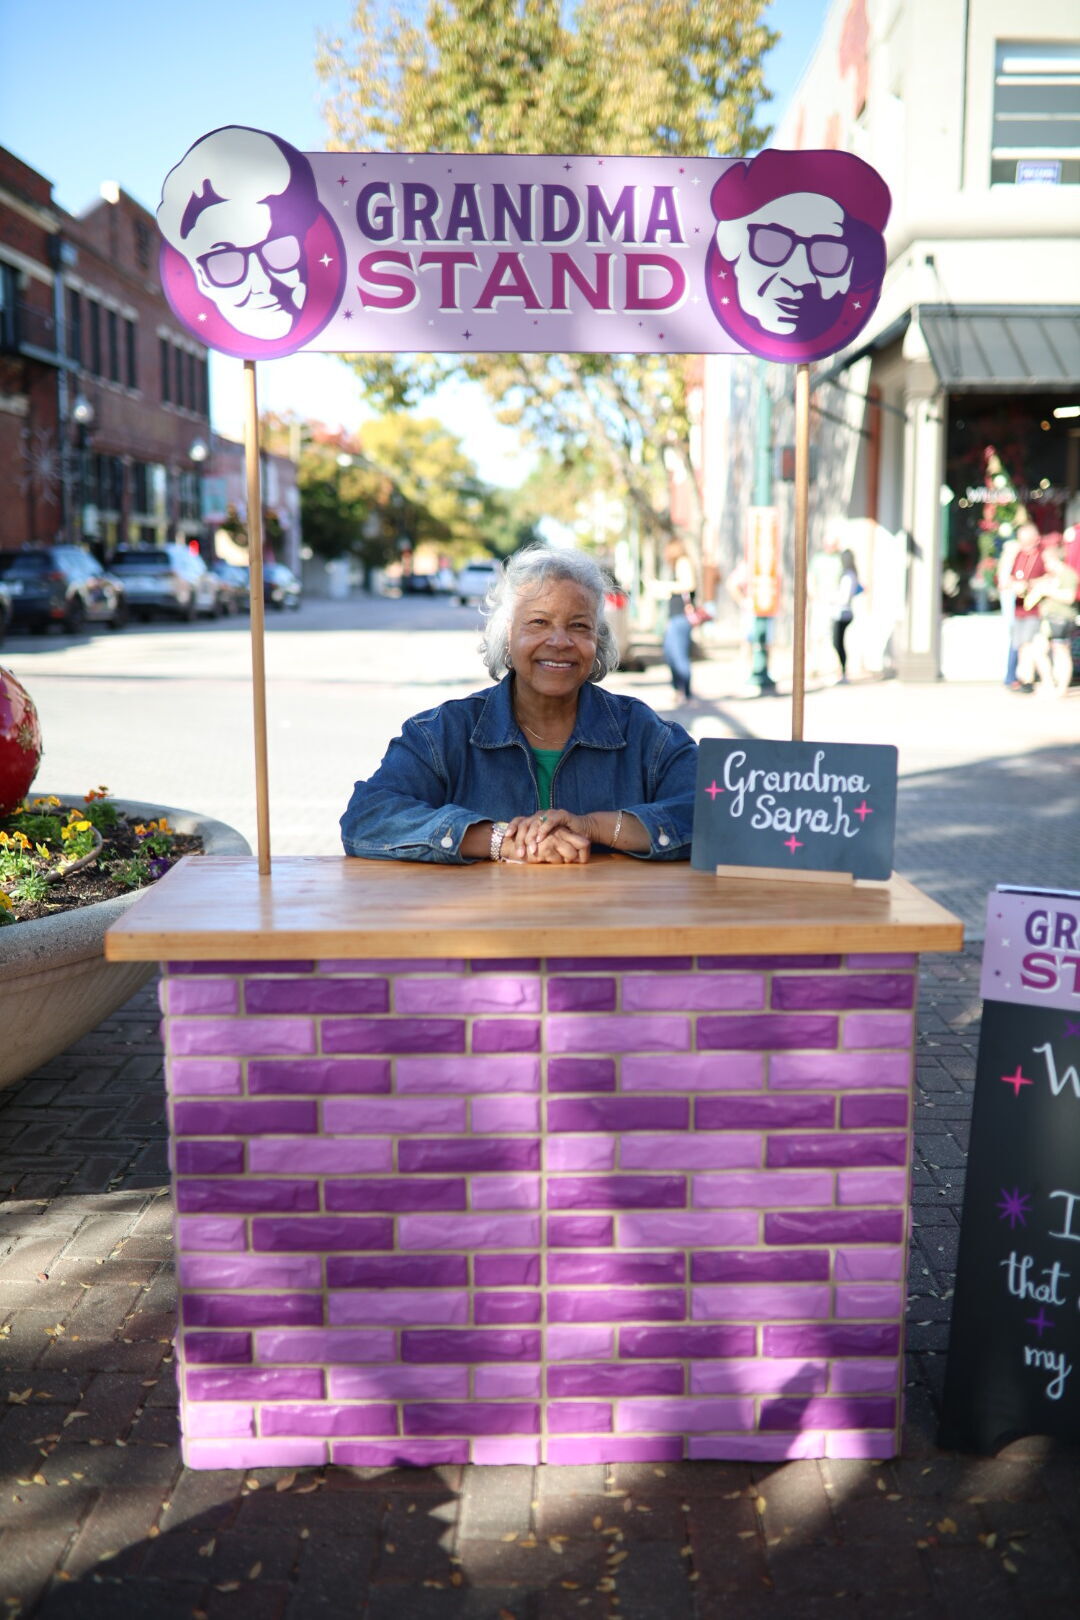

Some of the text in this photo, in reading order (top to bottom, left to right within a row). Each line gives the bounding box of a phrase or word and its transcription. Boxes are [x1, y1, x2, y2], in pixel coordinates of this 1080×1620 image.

[356, 181, 690, 247] GRANDMA
[357, 250, 690, 314] STAND
[723, 750, 871, 818] Grandma
[750, 794, 860, 838] Sarah
[1000, 1251, 1071, 1305] that
[1024, 1345, 1072, 1400] my
